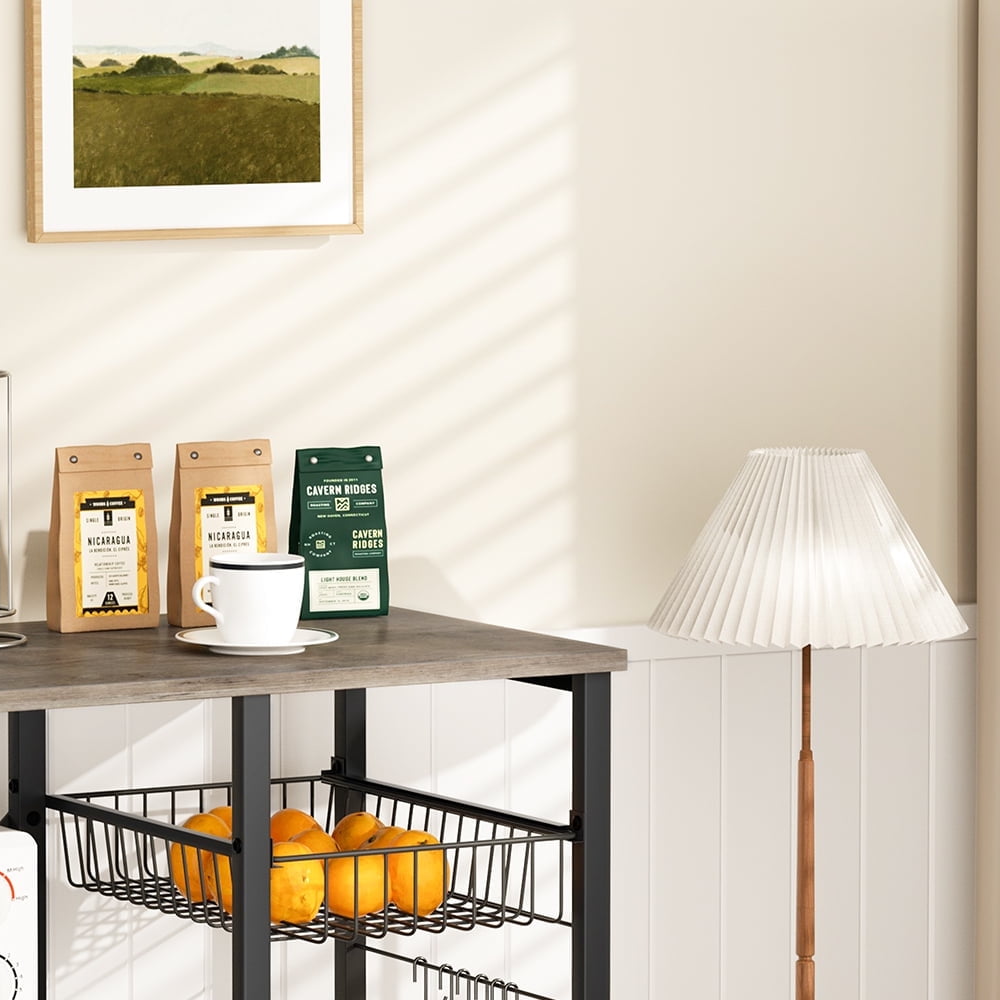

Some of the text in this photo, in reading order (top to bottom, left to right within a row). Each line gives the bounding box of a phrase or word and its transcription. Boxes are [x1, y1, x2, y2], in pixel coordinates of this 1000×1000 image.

[306, 483, 378, 496] CAVERN RIDGES
[208, 530, 251, 541] NICARAGUA
[352, 528, 382, 540] CAVERN
[87, 535, 131, 546] NICARAGUA
[352, 539, 384, 550] RIDGES
